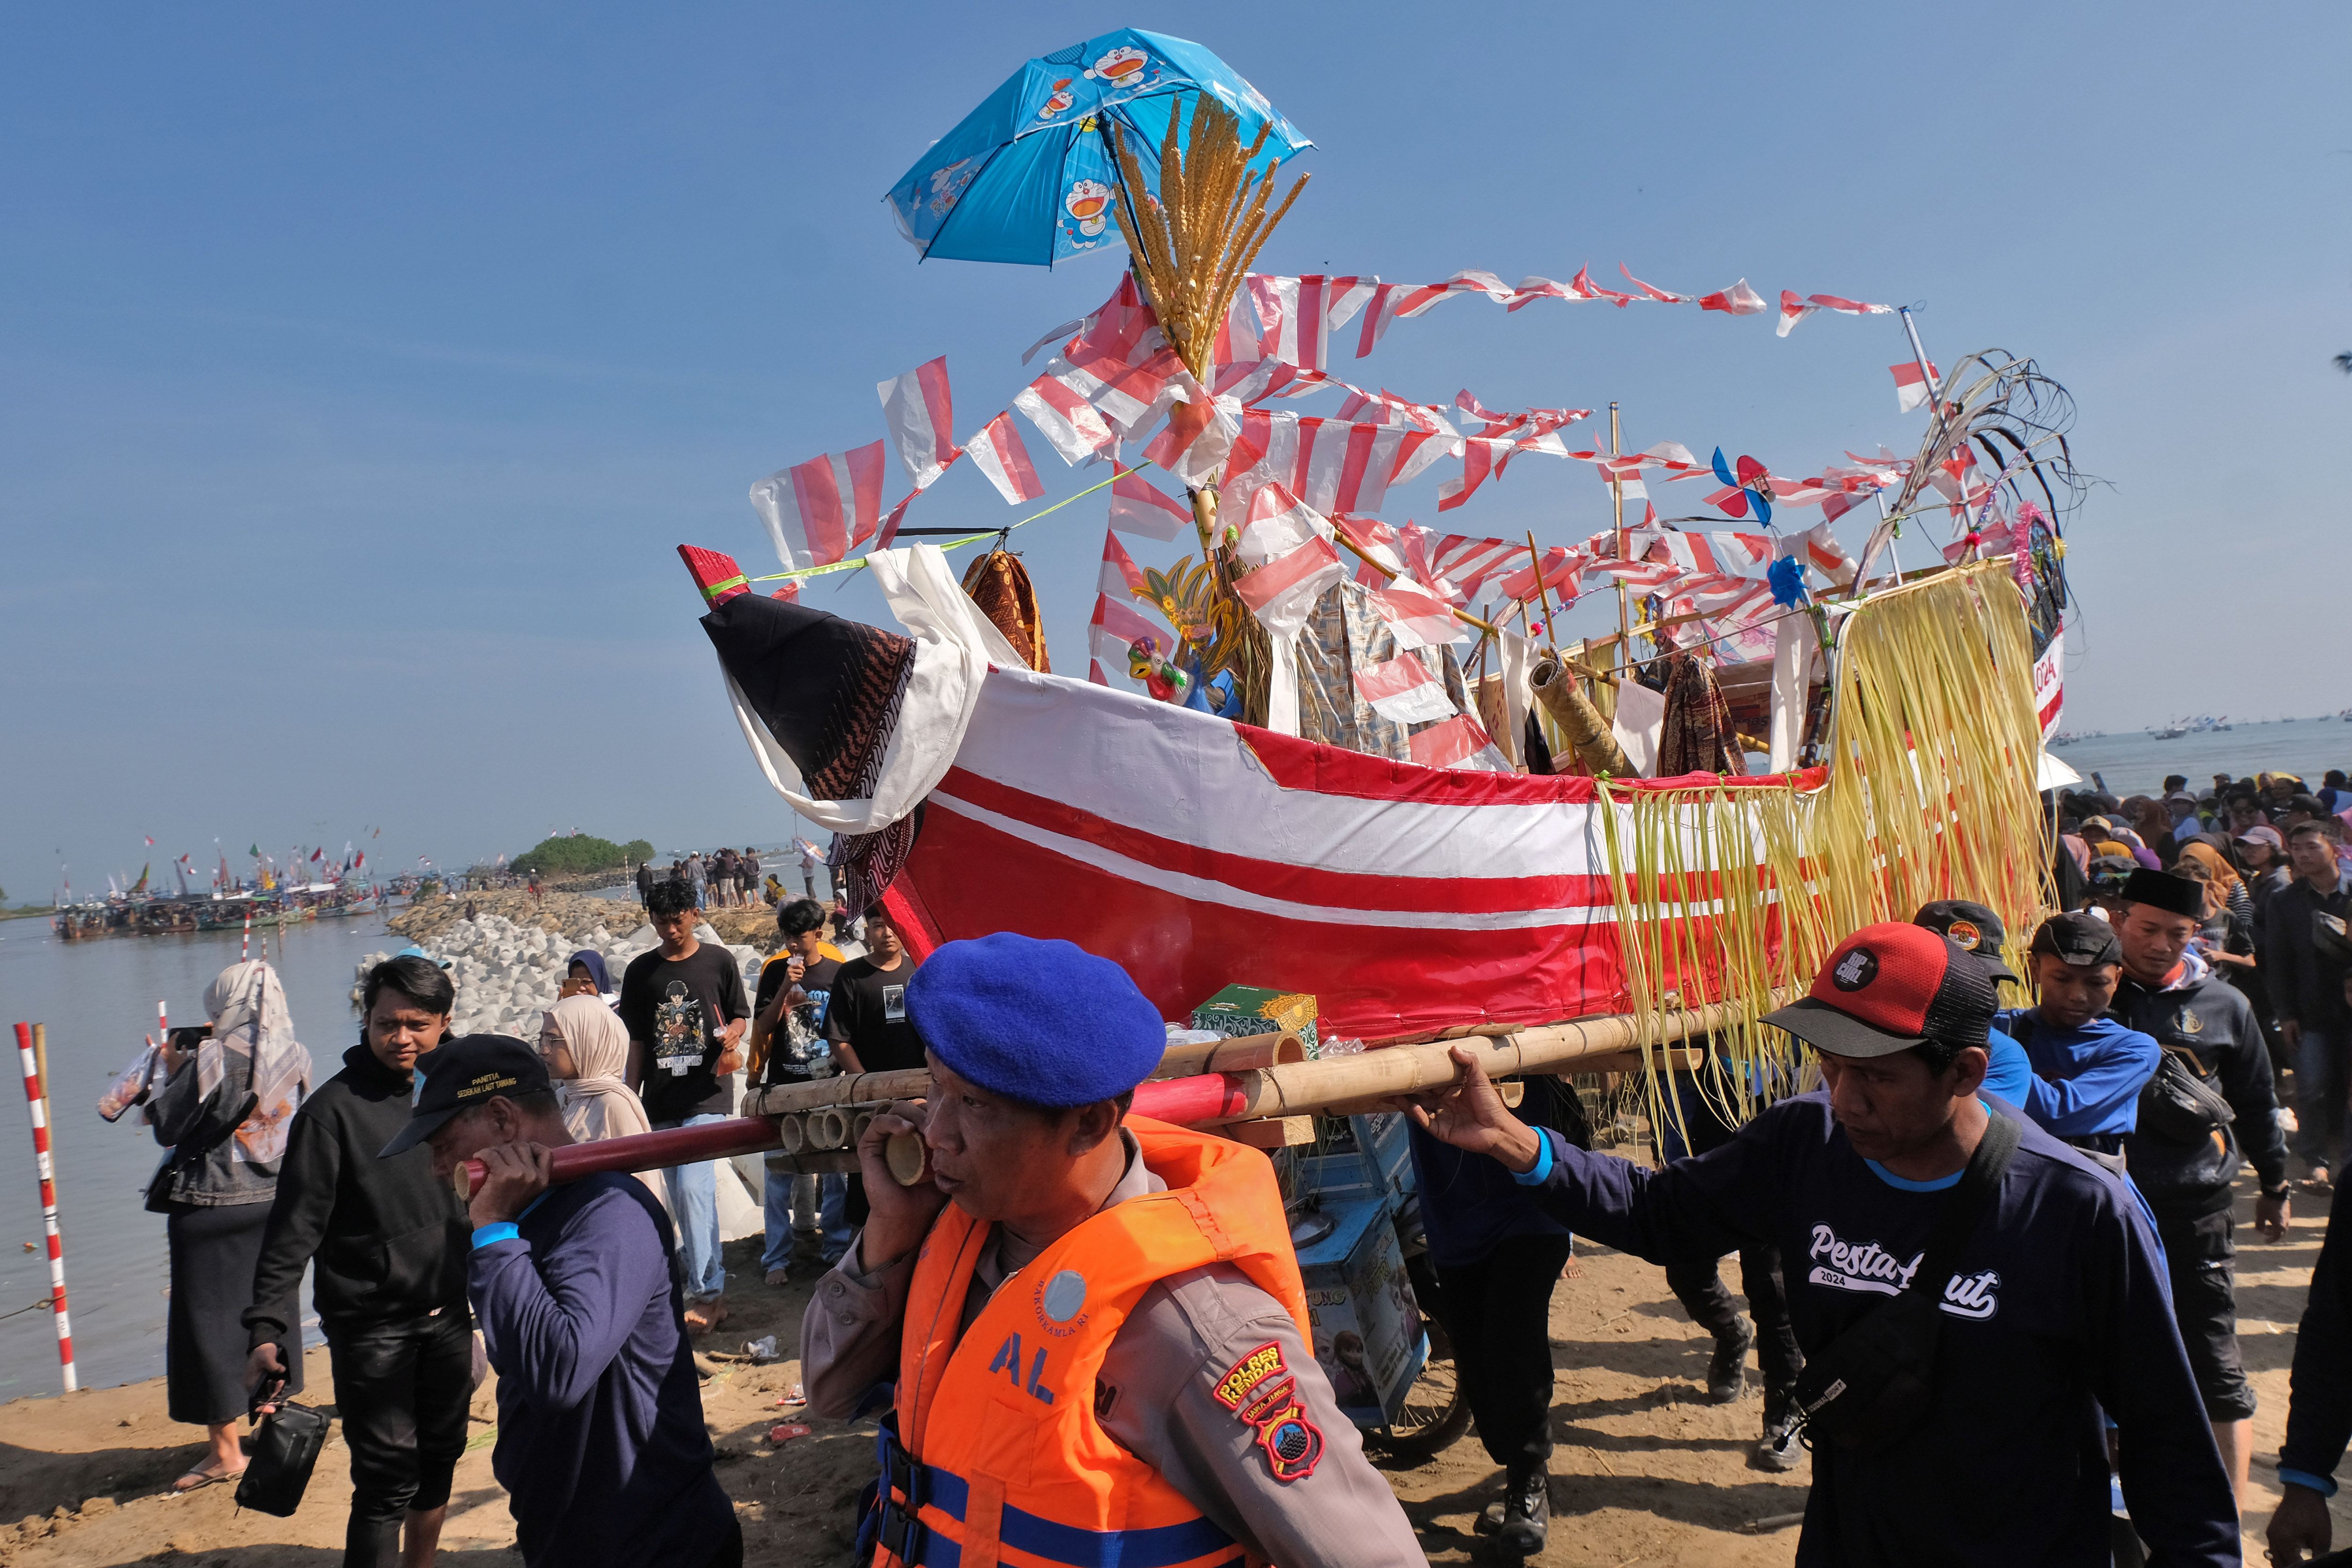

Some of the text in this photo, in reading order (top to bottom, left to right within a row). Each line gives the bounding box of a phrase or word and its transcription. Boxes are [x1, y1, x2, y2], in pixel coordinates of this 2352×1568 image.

[2035, 654, 2057, 697] 024
[1847, 951, 1868, 968] RIP
[1836, 962, 1862, 983] CURL
[472, 1072, 500, 1085] PANITIA
[457, 1086, 482, 1098] SEDEKAH
[481, 1082, 495, 1092] LAUT
[1810, 1225, 1897, 1280] Pesta
[1821, 1271, 1846, 1286] 2024
[1306, 1290, 1346, 1306] UNG
[1077, 1314, 1089, 1327] RI
[988, 1331, 1054, 1405] AL
[1219, 1347, 1279, 1405] POLRES
[1230, 1359, 1282, 1401] KENDAL
[1247, 1402, 1266, 1419] JAWA
